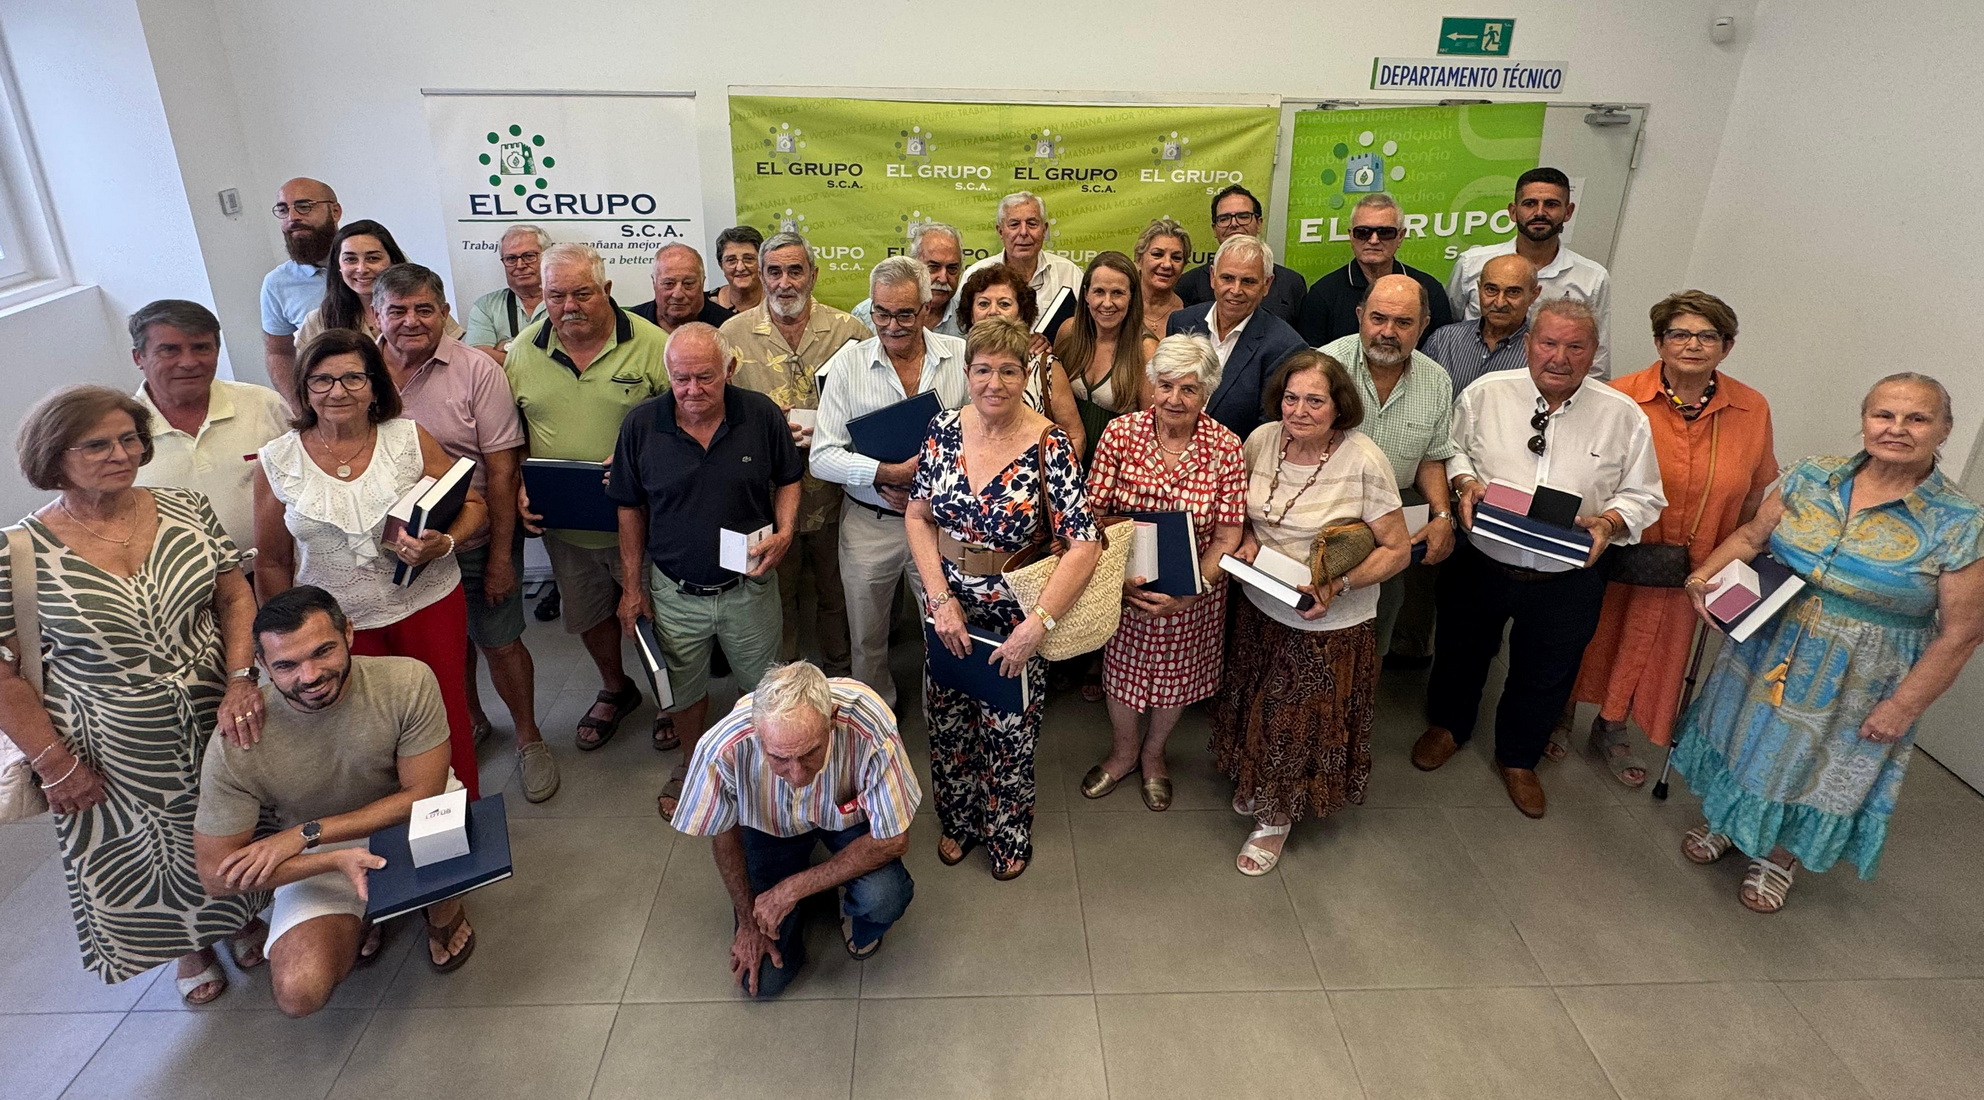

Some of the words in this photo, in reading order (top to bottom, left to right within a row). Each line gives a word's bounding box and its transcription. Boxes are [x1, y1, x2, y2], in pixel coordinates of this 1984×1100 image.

[1380, 65, 1498, 88] DEPARTAMENTO
[1502, 63, 1562, 89] TÉCNICO
[755, 161, 783, 176] EL
[787, 162, 864, 177] GRUPO
[886, 163, 913, 178] EL
[917, 164, 992, 179] GRUPO
[1013, 166, 1040, 181] EL
[1044, 167, 1118, 182] GRUPO
[1139, 168, 1166, 183] EL
[1170, 169, 1244, 184] GRUPO
[826, 180, 864, 189] S.C.A.
[954, 182, 991, 191] S.C.A.
[1080, 184, 1117, 194] S.C.A.
[469, 193, 518, 216] EL
[525, 193, 657, 216] GRUPO
[620, 224, 684, 238] S.C.A.
[1299, 216, 1351, 243] EL
[1403, 209, 1518, 238] RUPO
[627, 240, 662, 252] mejor
[811, 246, 865, 260] RUPO
[609, 256, 616, 265] a
[619, 254, 655, 265] better
[828, 262, 865, 271] S.C.A.
